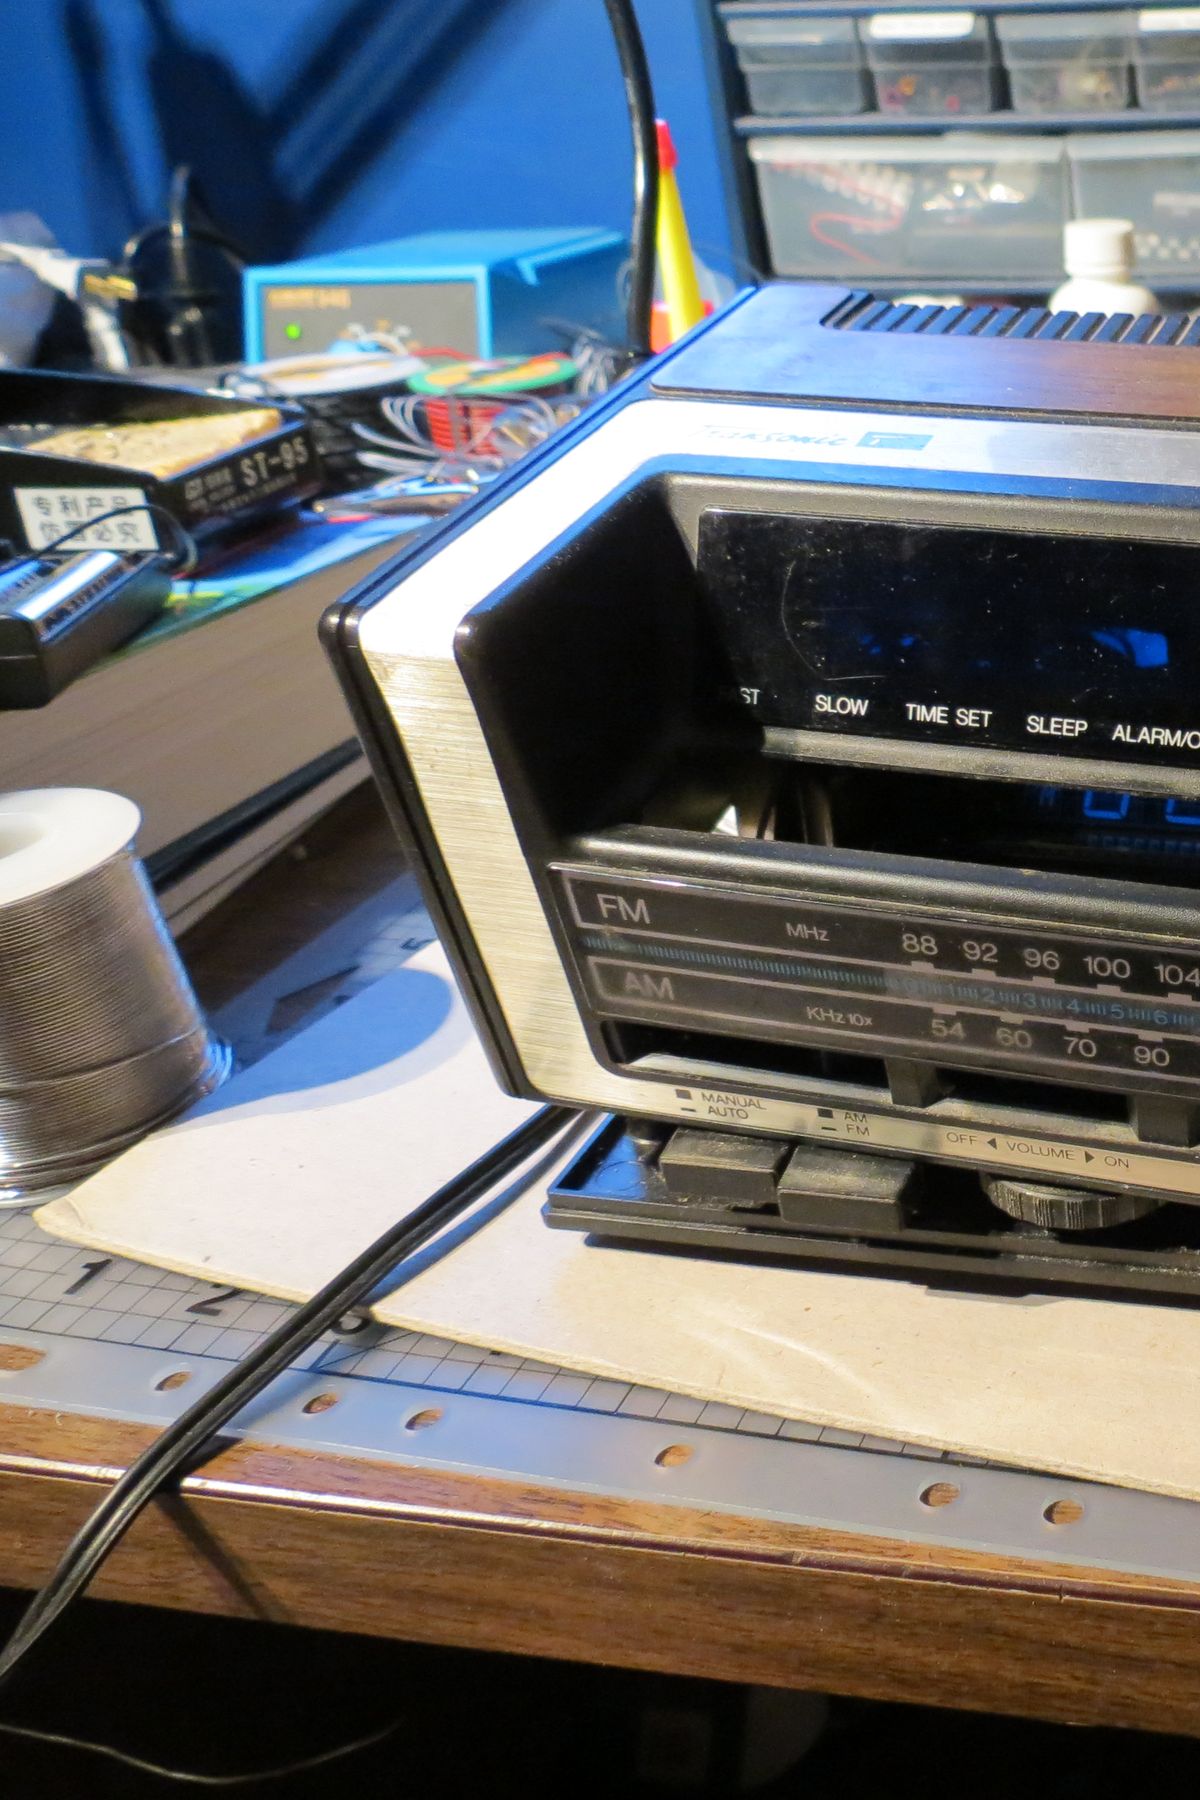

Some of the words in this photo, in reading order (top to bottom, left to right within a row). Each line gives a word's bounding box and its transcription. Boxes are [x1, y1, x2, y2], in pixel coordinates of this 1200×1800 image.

[814, 694, 869, 716] SLOW
[906, 703, 948, 726] TIME
[956, 709, 992, 729] SET
[1026, 715, 1088, 738] SLEEP
[597, 893, 651, 924] FM
[785, 922, 830, 942] MHz
[902, 933, 939, 956] 88
[963, 940, 999, 963] 92
[1023, 948, 1061, 971] 96
[1083, 955, 1131, 979] 100
[624, 972, 675, 1001] AM
[1023, 992, 1038, 1009] 3
[1065, 1000, 1080, 1014] 4
[1109, 1004, 1125, 1020] 5
[1154, 1009, 1169, 1025] 6
[930, 1018, 966, 1040] 54
[997, 1027, 1033, 1049] 60
[1063, 1036, 1097, 1058] 70
[1134, 1045, 1170, 1067] 90
[701, 1092, 767, 1111] MANUAL
[708, 1104, 750, 1120] AUTO
[844, 1111, 868, 1123] AM
[846, 1124, 870, 1137] FM
[946, 1131, 978, 1145] OFF
[1006, 1140, 1076, 1162] VOLUME
[1105, 1155, 1131, 1170] ON
[65, 1259, 111, 1295] 1
